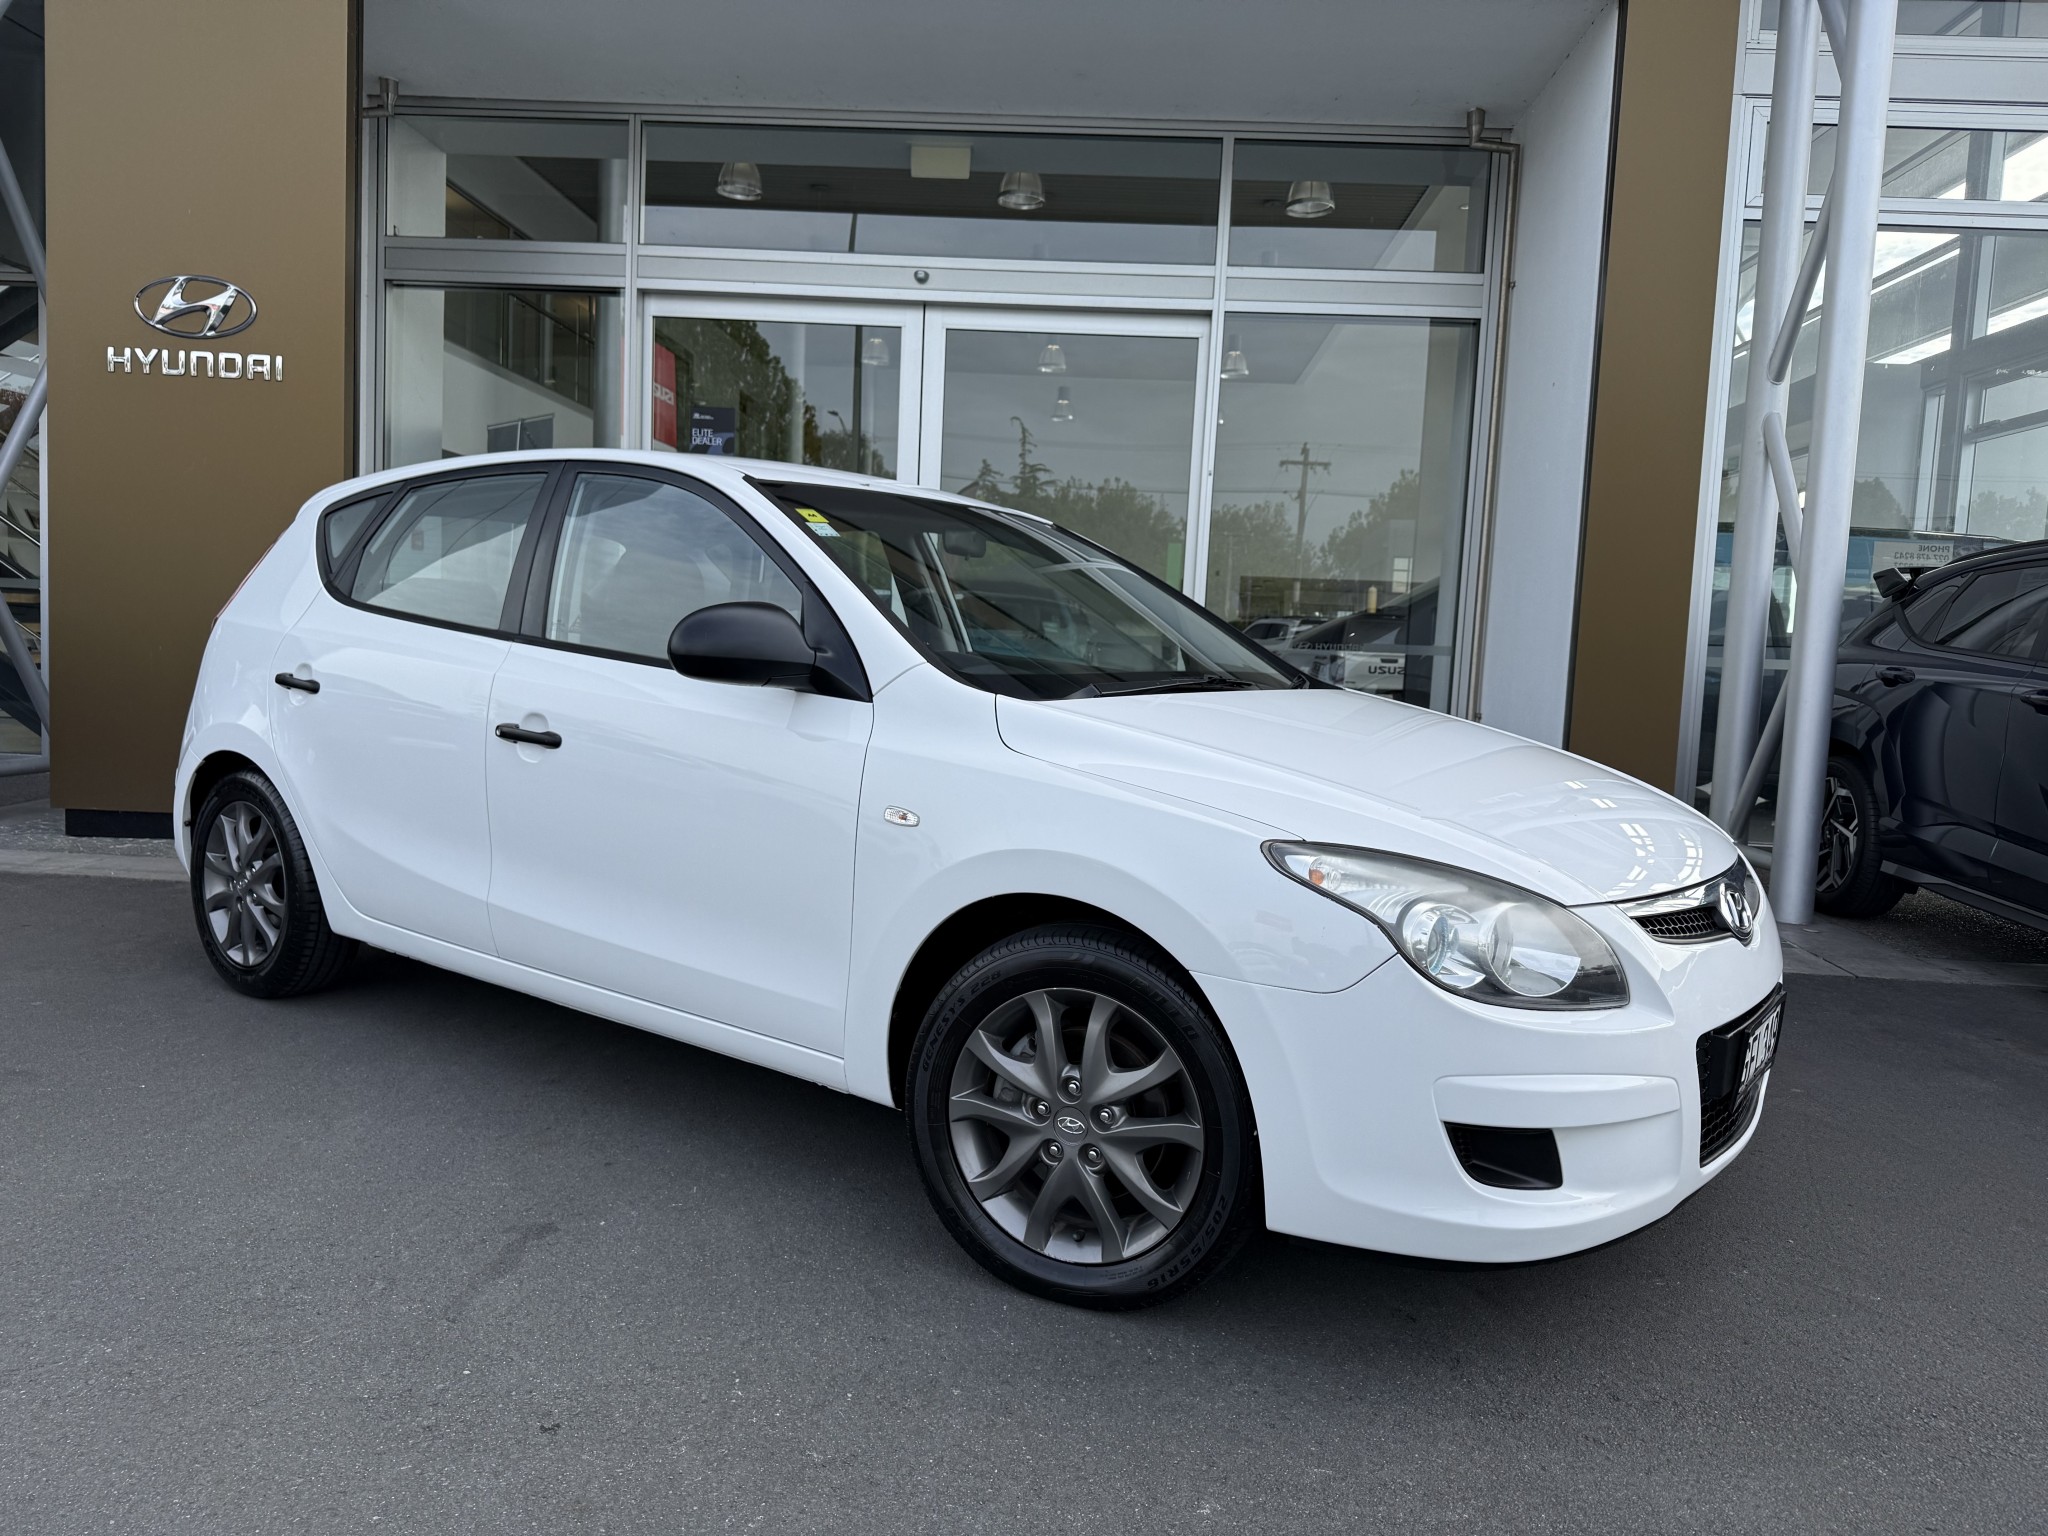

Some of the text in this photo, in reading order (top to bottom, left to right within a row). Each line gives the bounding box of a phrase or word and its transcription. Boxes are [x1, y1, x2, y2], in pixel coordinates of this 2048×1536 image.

[106, 346, 285, 382] HYUNDAI
[691, 427, 714, 438] ELITE
[691, 436, 723, 446] DEALER
[922, 970, 1002, 1073] GENESYS 228
[1146, 1194, 1229, 1290] 205/55R16
